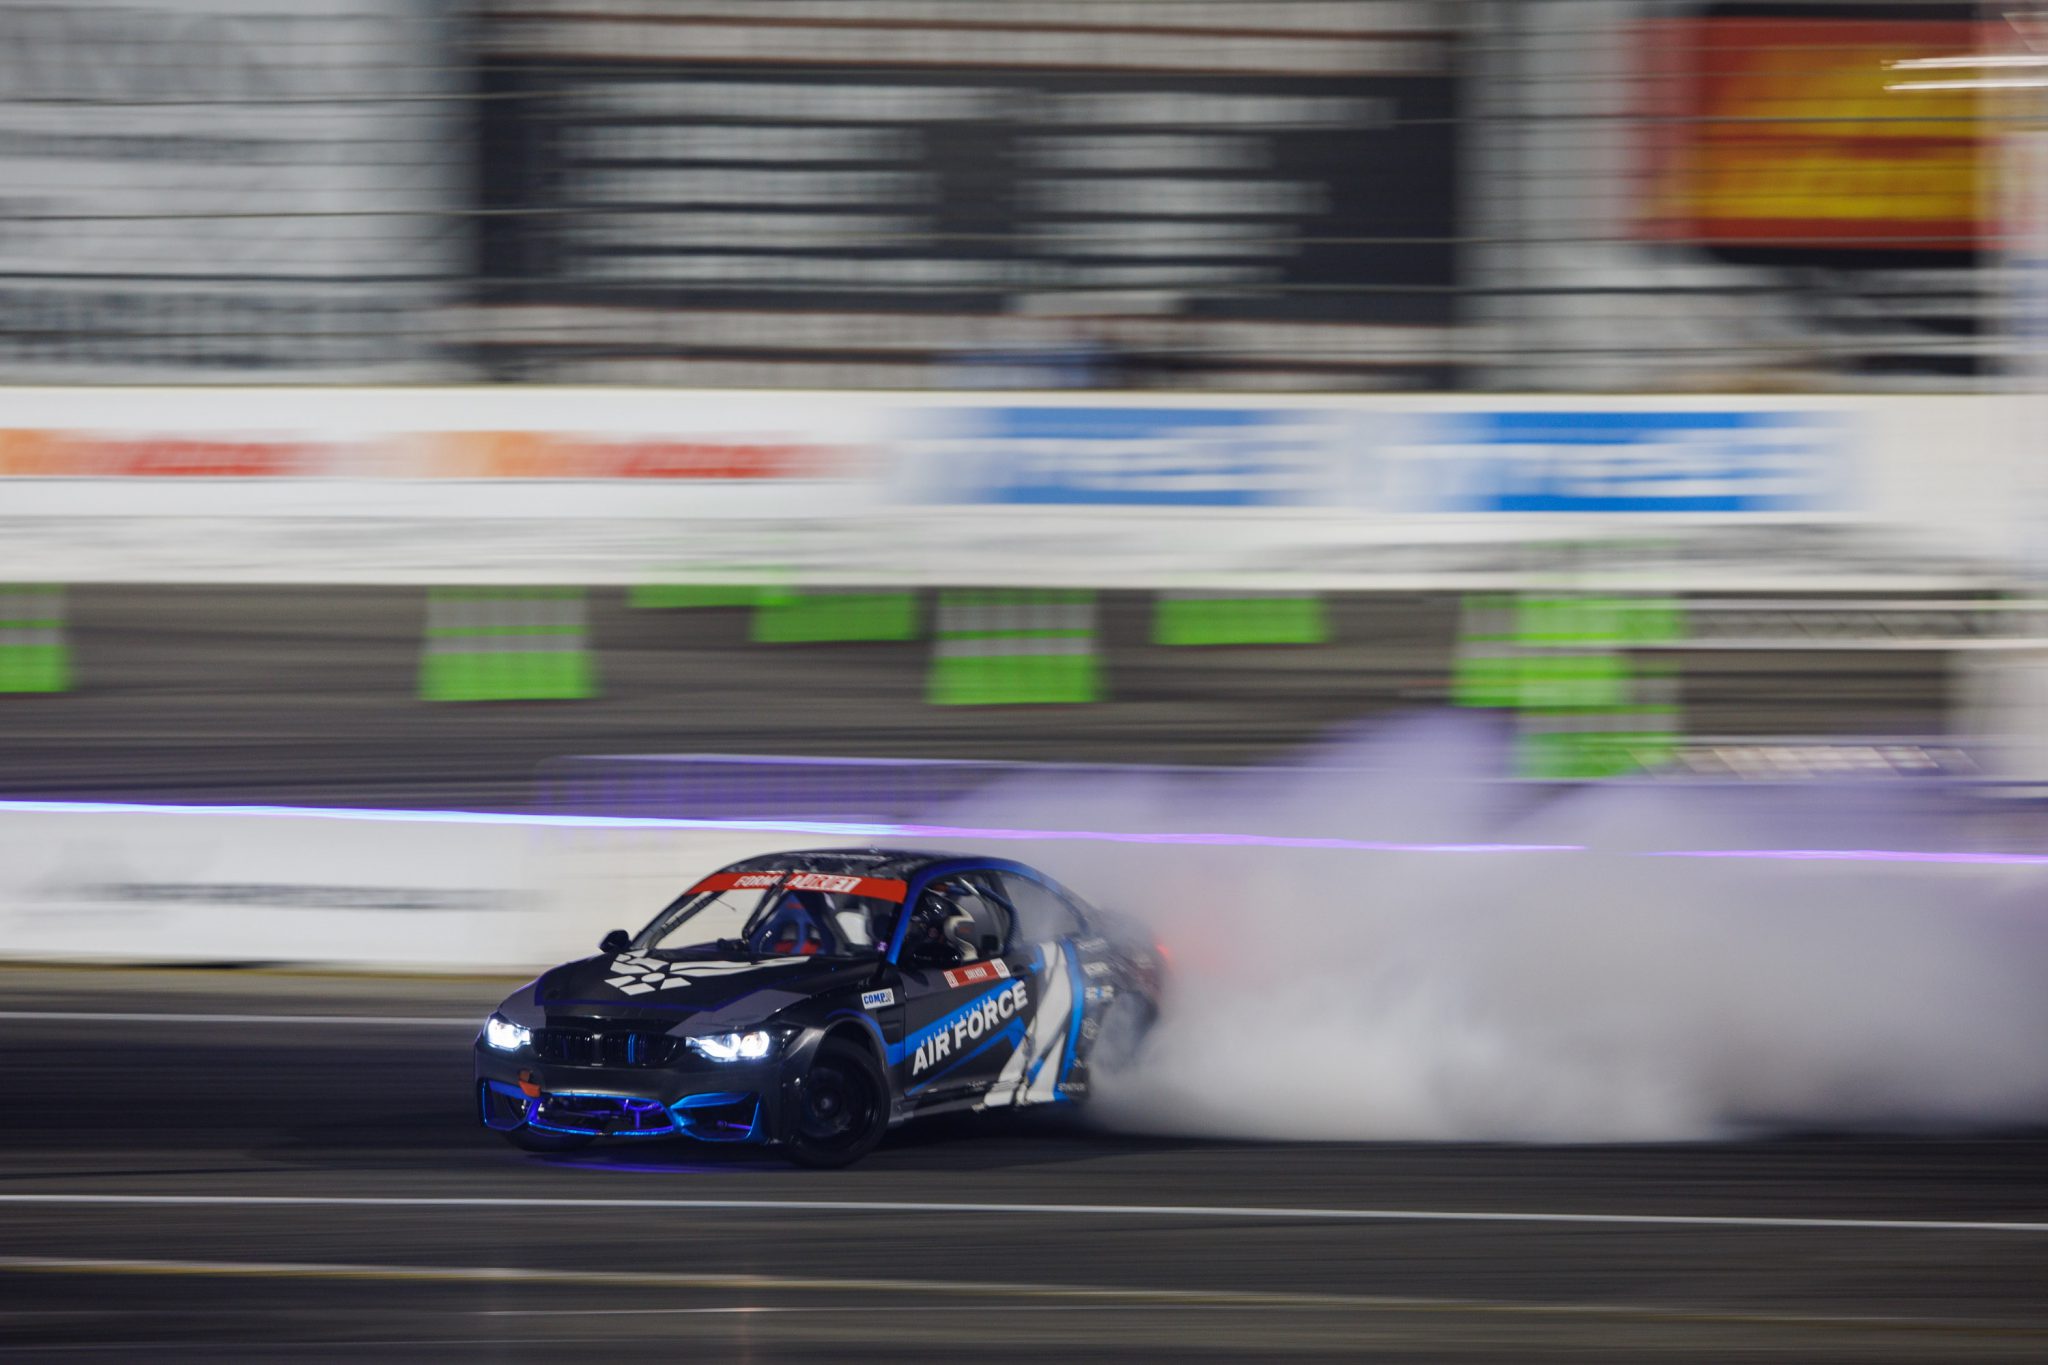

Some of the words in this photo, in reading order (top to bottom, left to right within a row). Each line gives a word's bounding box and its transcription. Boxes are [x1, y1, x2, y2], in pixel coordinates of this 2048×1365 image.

[798, 874, 861, 892] DRIFT
[912, 1031, 951, 1076] AIR
[954, 980, 1028, 1049] FORCE
